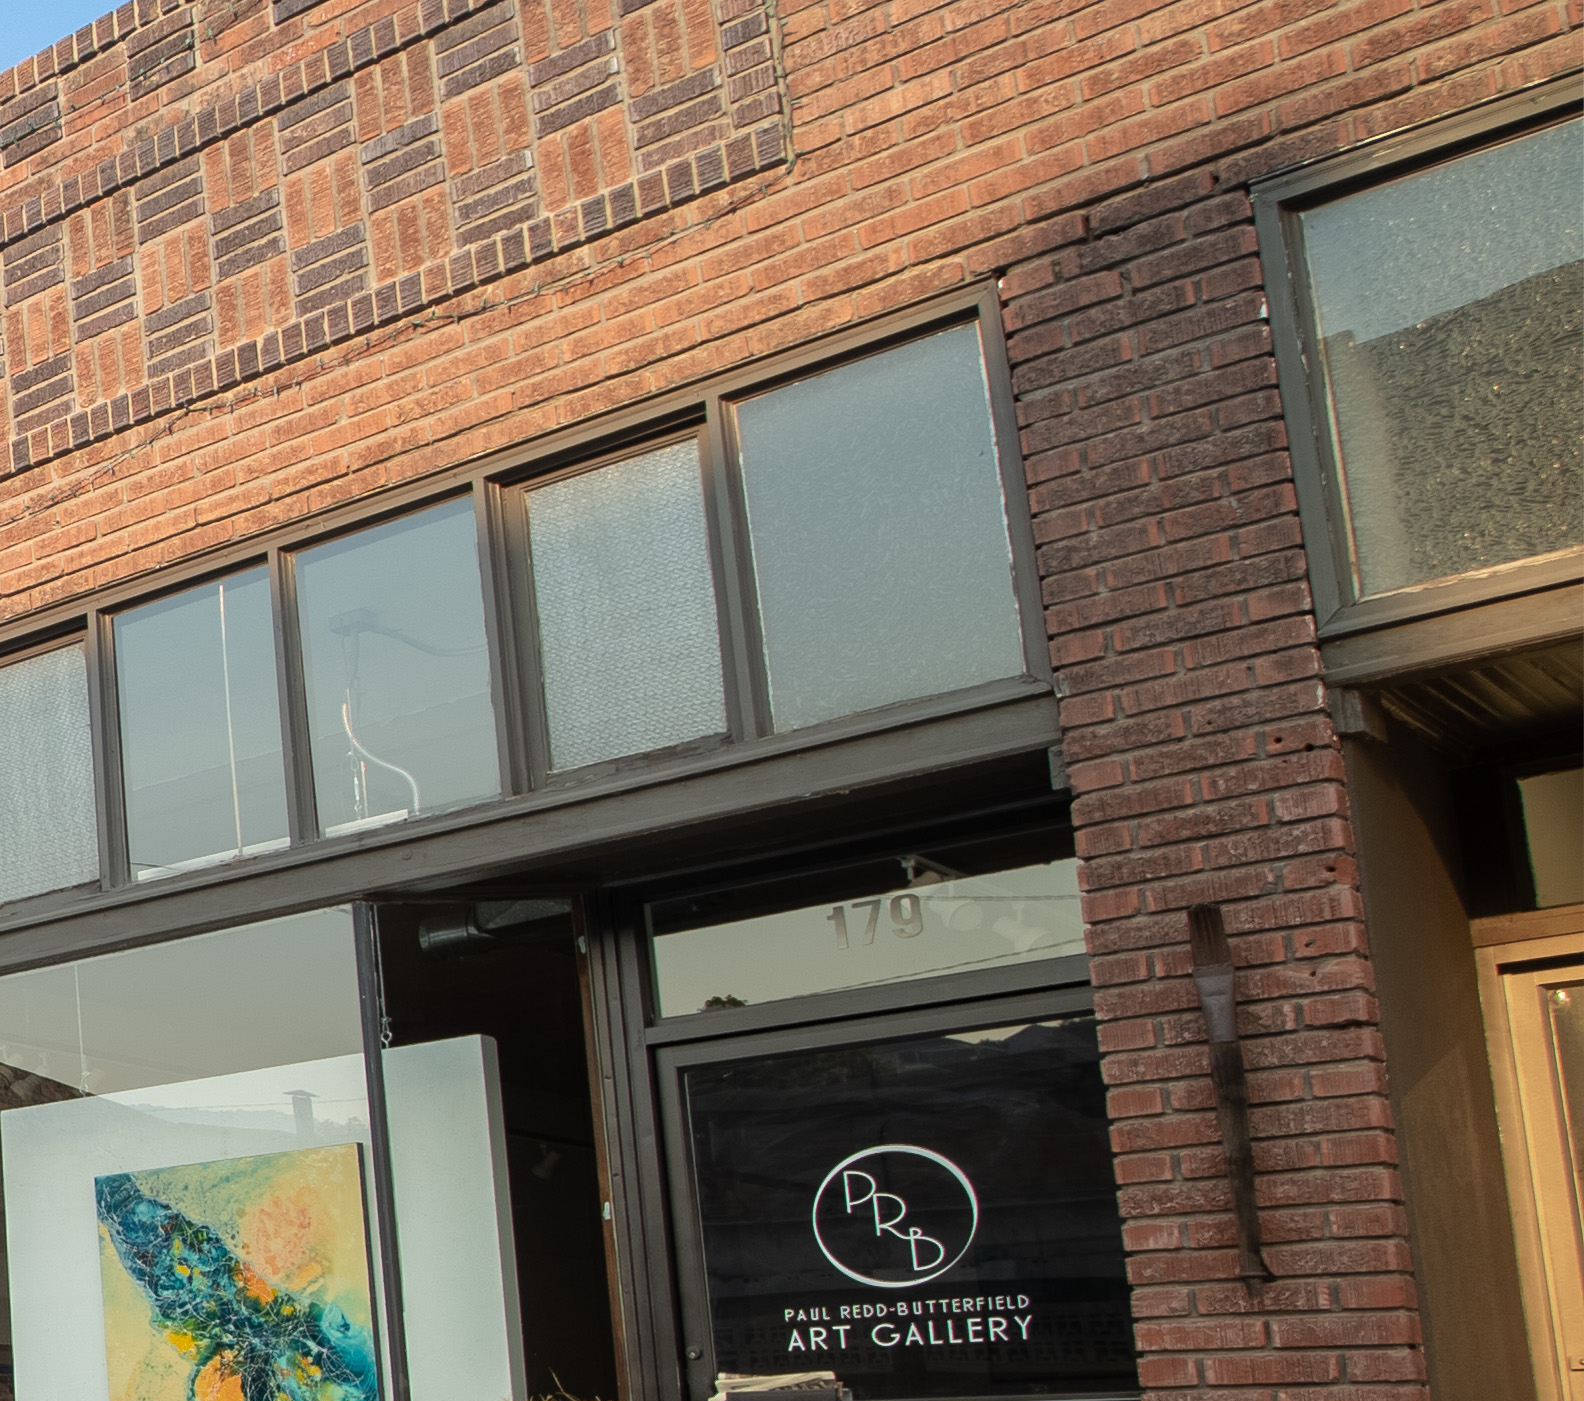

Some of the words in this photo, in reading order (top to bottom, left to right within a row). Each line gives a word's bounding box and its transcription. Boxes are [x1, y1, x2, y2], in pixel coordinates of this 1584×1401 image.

[826, 893, 924, 950] 179
[784, 1307, 831, 1322] PAUL
[840, 1294, 1030, 1319] REDD-BUTTERFIELD
[788, 1325, 851, 1351] ART
[871, 1315, 1032, 1346] GALLERY
